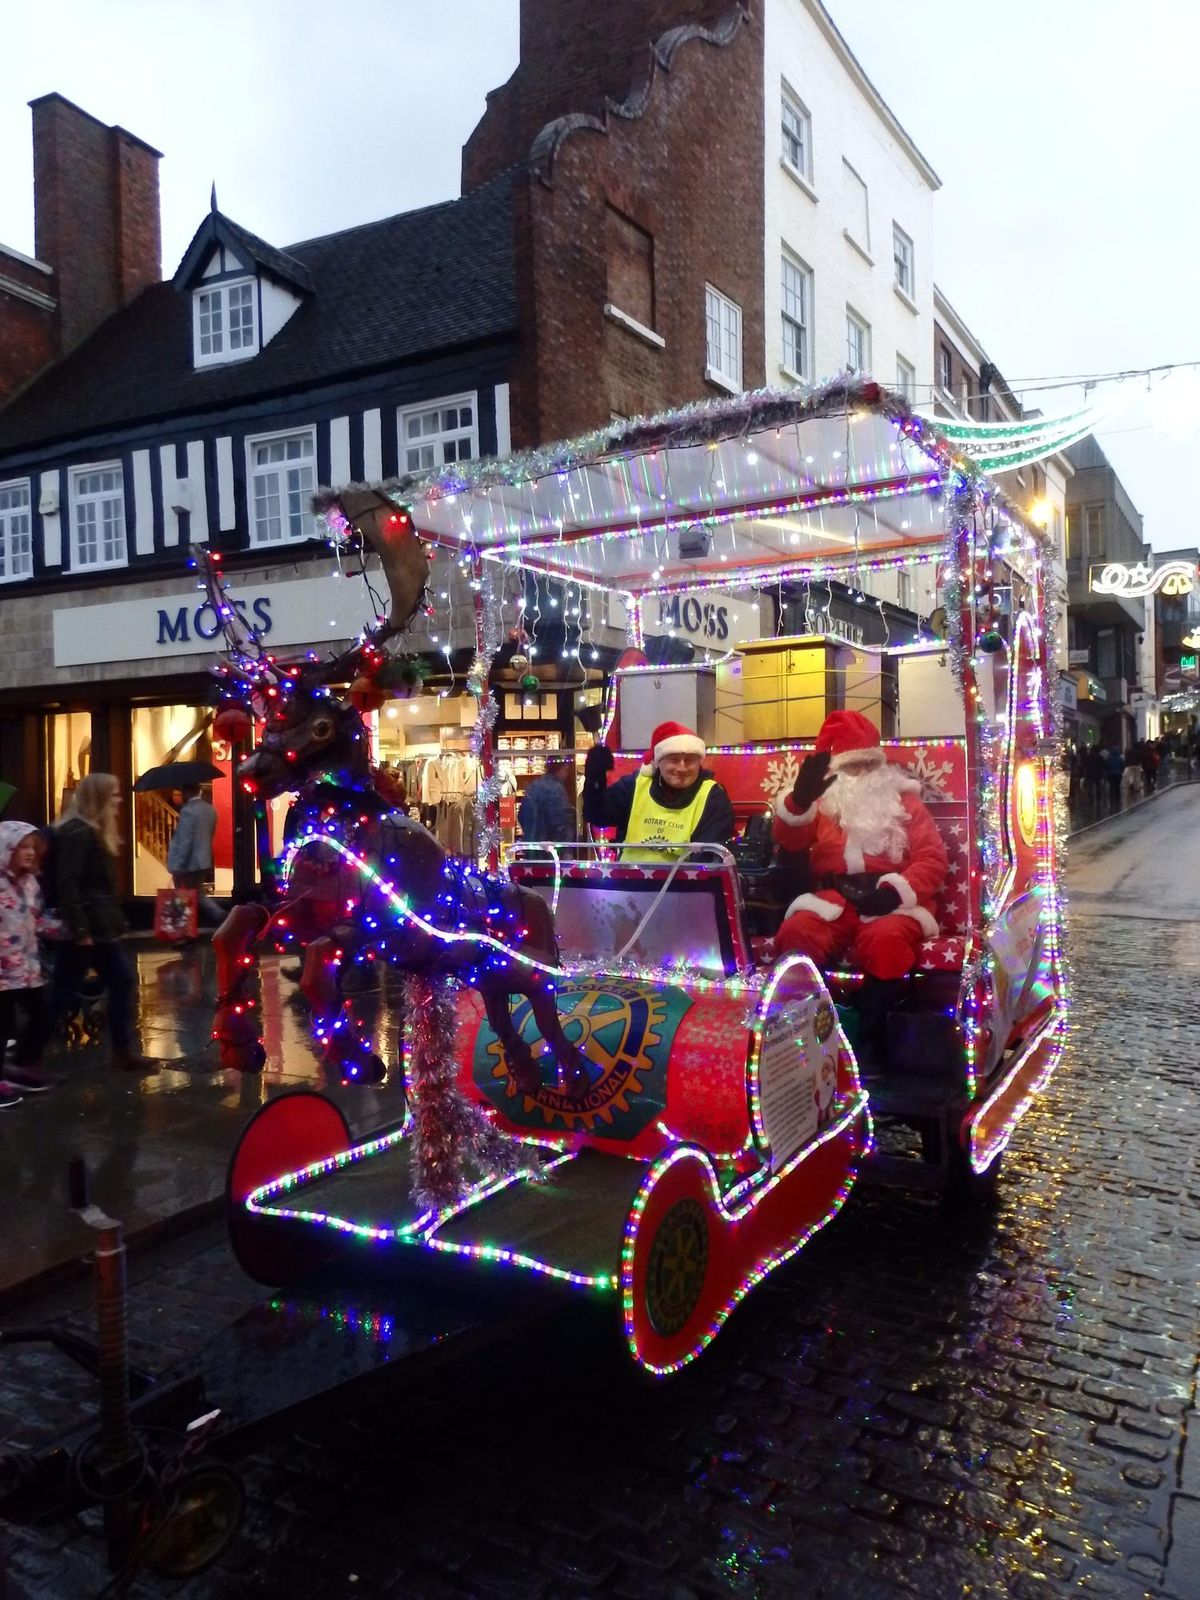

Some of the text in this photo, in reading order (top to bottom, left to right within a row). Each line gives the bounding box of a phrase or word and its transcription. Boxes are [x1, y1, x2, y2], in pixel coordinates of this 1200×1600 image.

[659, 594, 729, 640] MOSS
[643, 817, 685, 830] ROTARY CLUB
